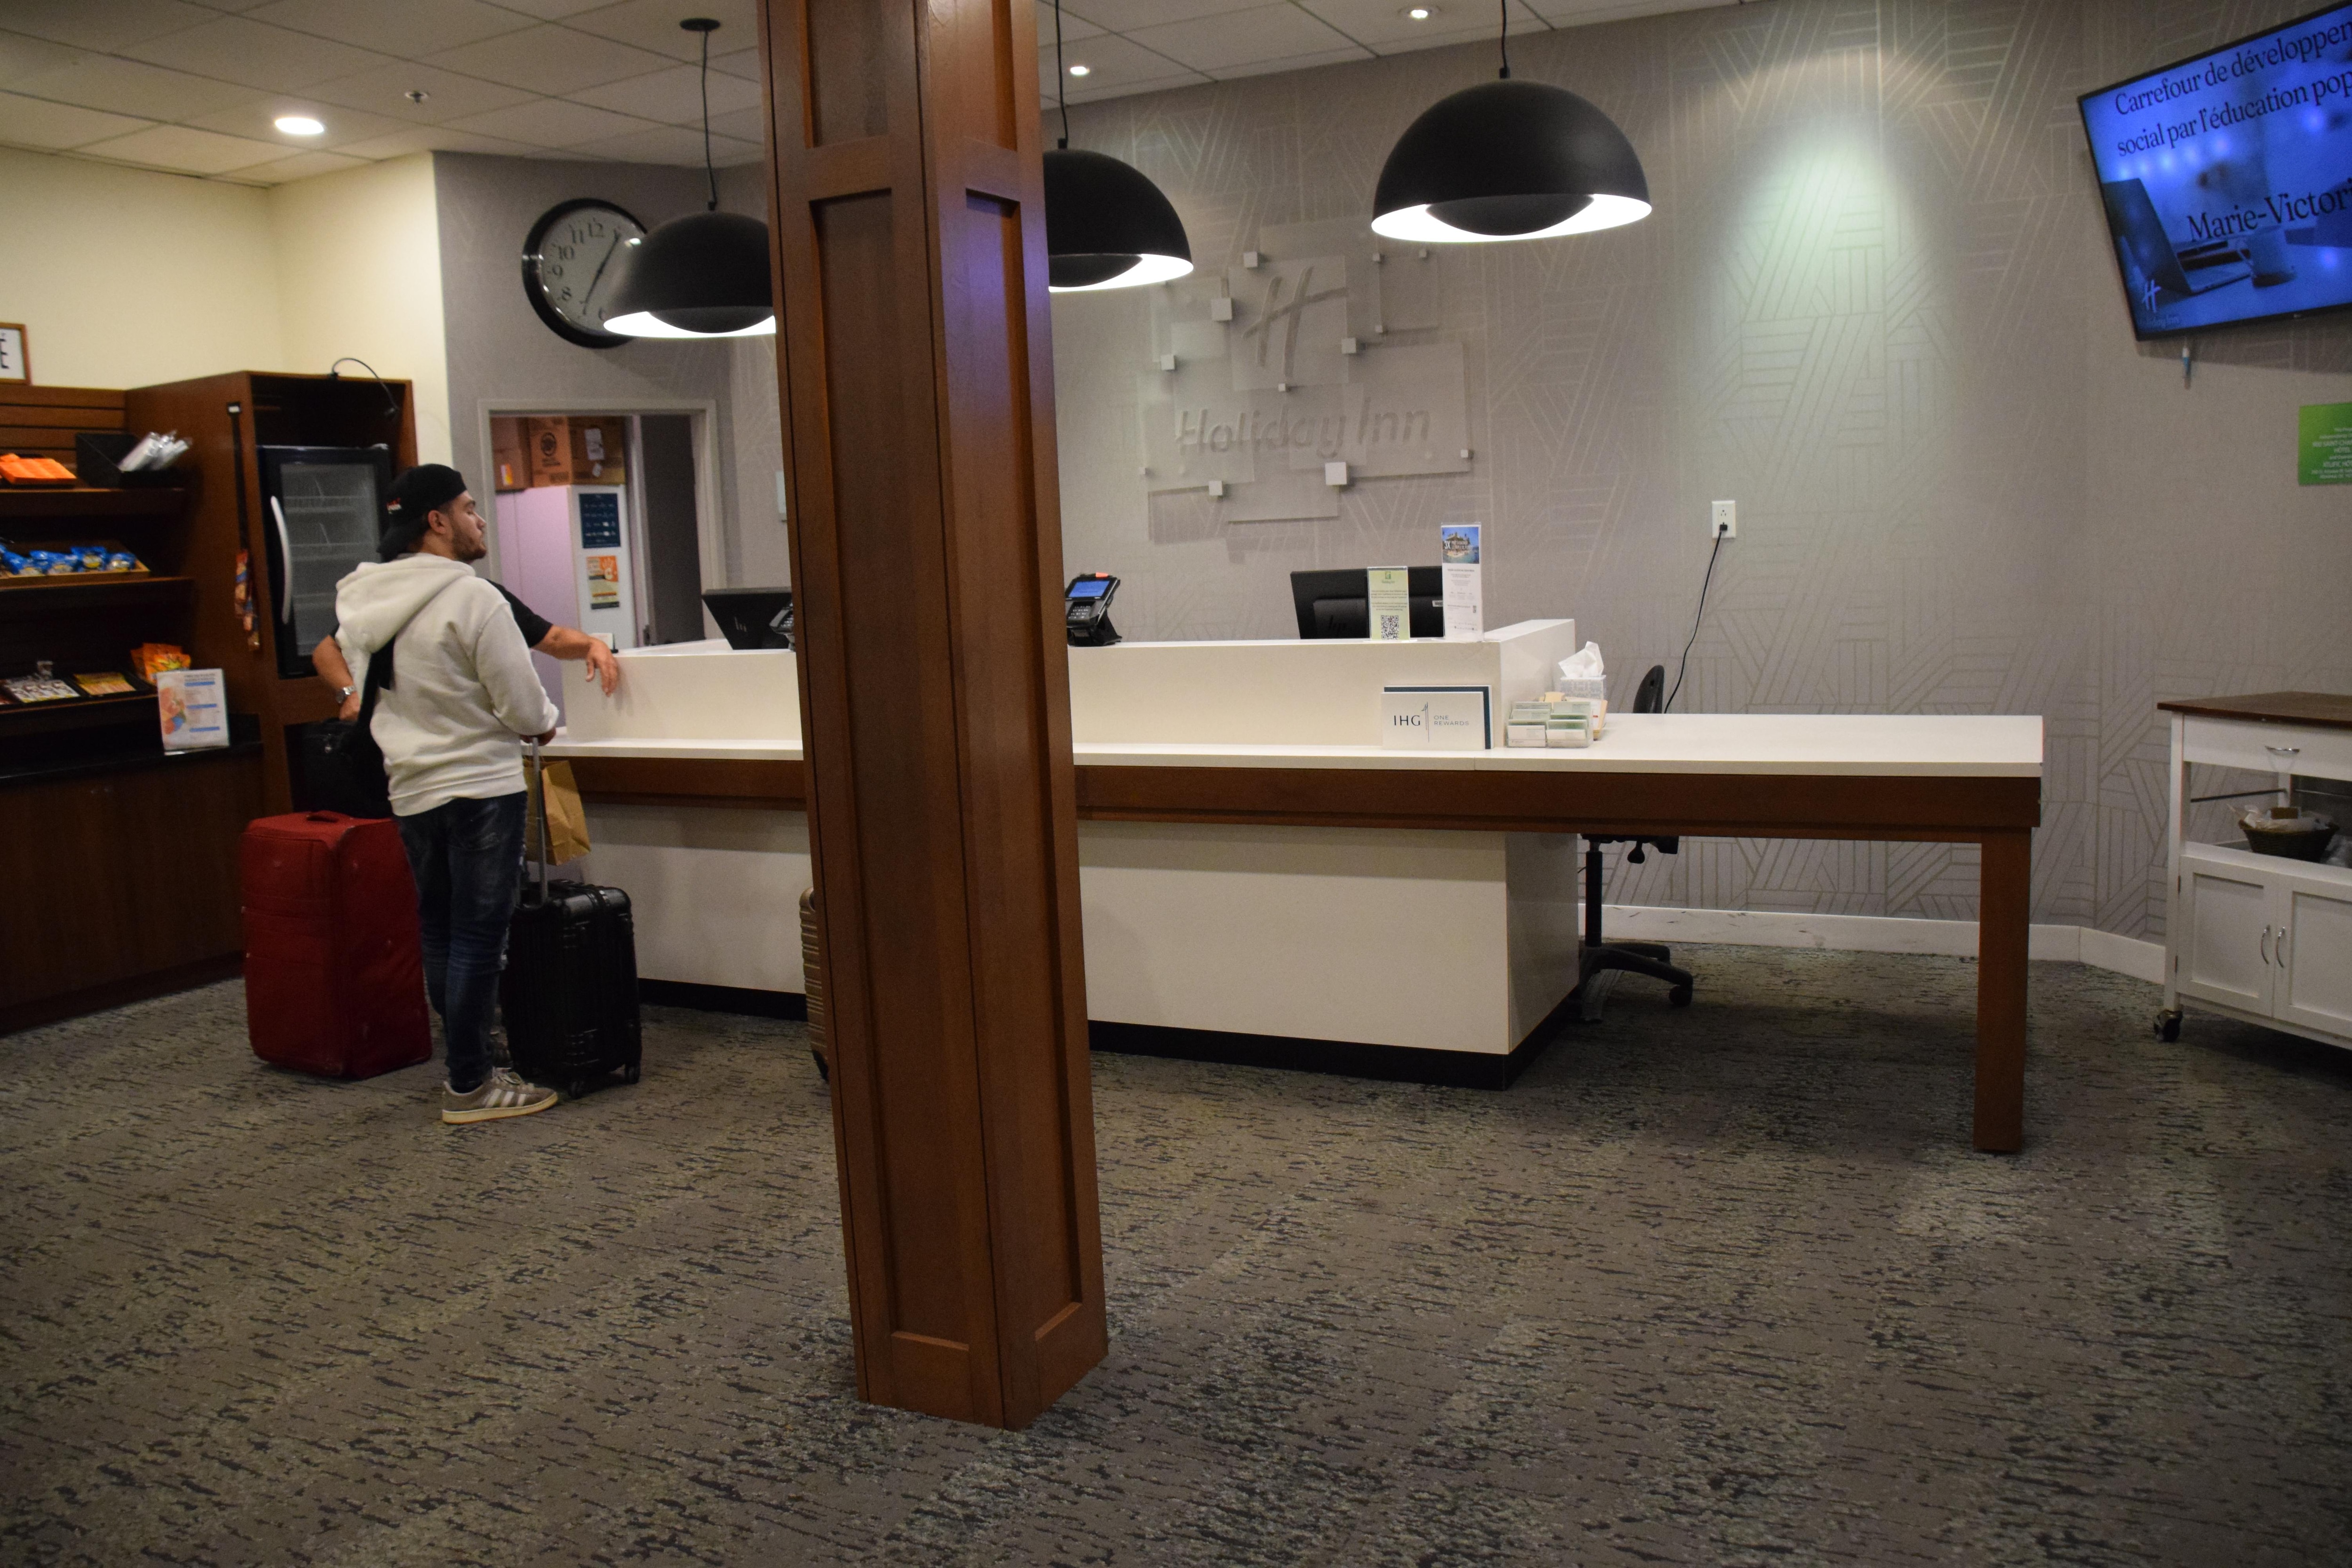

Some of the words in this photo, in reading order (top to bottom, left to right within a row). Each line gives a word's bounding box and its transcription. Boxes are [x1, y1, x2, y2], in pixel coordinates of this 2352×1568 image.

[2115, 73, 2201, 115] Carrefour
[2204, 62, 2229, 87] de
[2118, 123, 2165, 157] social
[2167, 117, 2197, 149] par
[2199, 85, 2308, 133] l'éducation
[588, 222, 605, 237] 12
[557, 245, 575, 260] 10
[1175, 404, 1347, 459] Holiday
[1356, 397, 1431, 444] Inn
[1393, 715, 1421, 726] IHG
